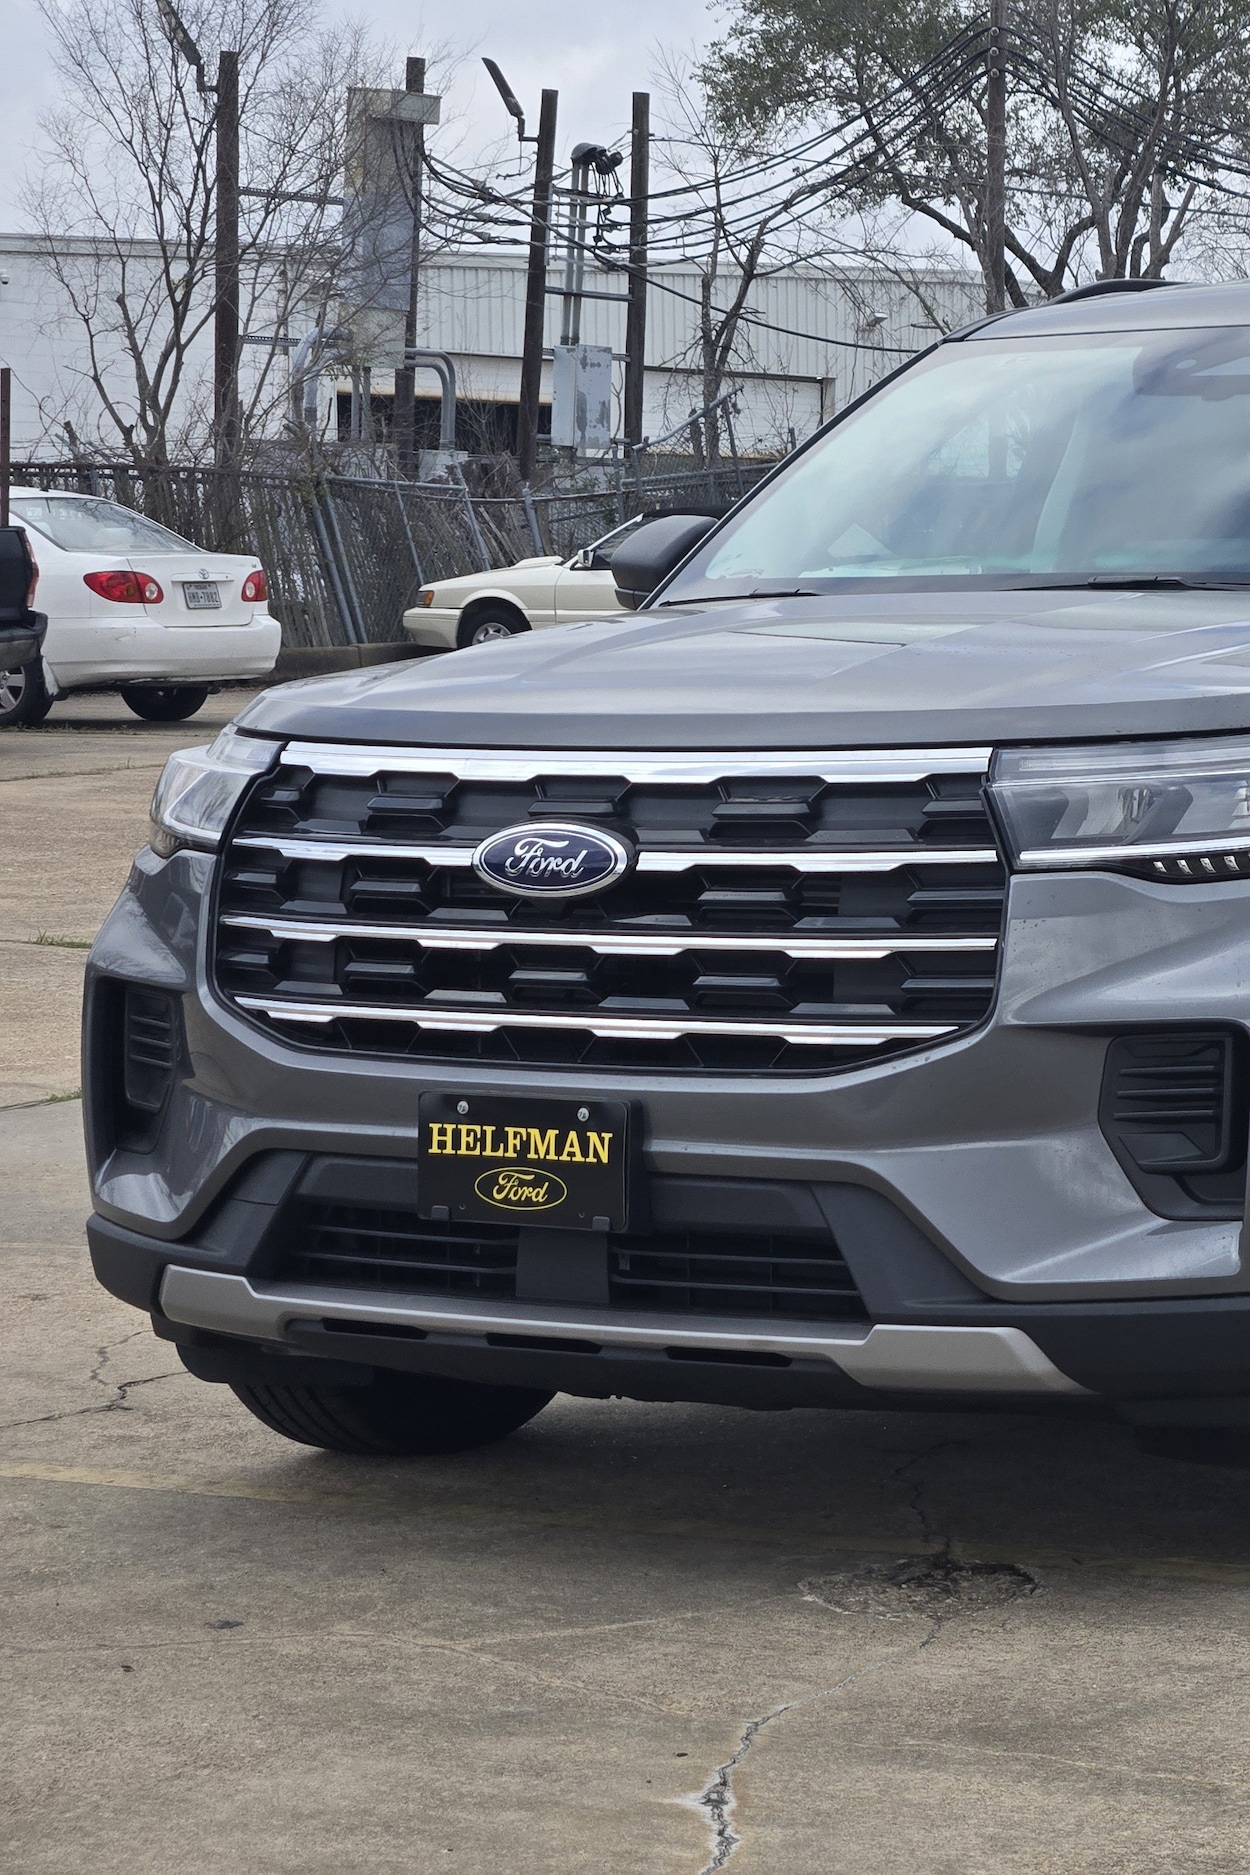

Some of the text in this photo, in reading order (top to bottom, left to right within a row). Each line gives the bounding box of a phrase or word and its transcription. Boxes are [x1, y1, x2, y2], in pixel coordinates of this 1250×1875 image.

[504, 837, 589, 878] Ford
[427, 1122, 613, 1164] HELFMAN
[492, 1171, 550, 1204] Ford
